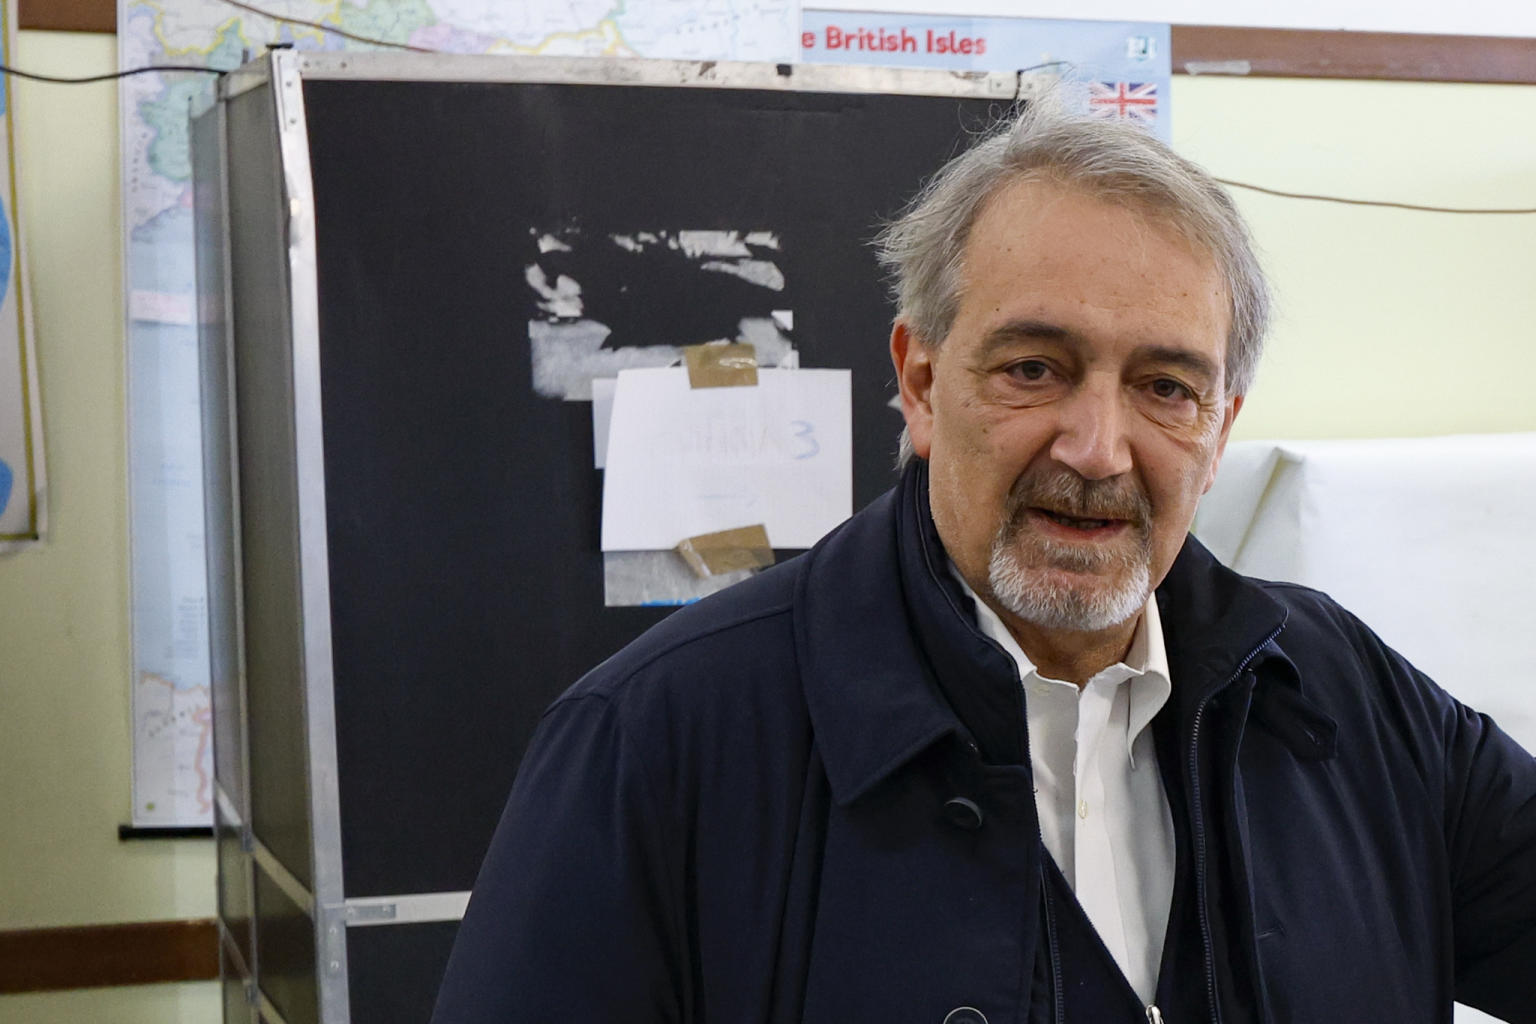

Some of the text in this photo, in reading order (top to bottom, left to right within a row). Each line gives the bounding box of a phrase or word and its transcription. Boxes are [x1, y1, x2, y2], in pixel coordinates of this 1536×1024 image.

[826, 25, 917, 52] British
[927, 30, 986, 55] Isles
[791, 419, 821, 460] 3
